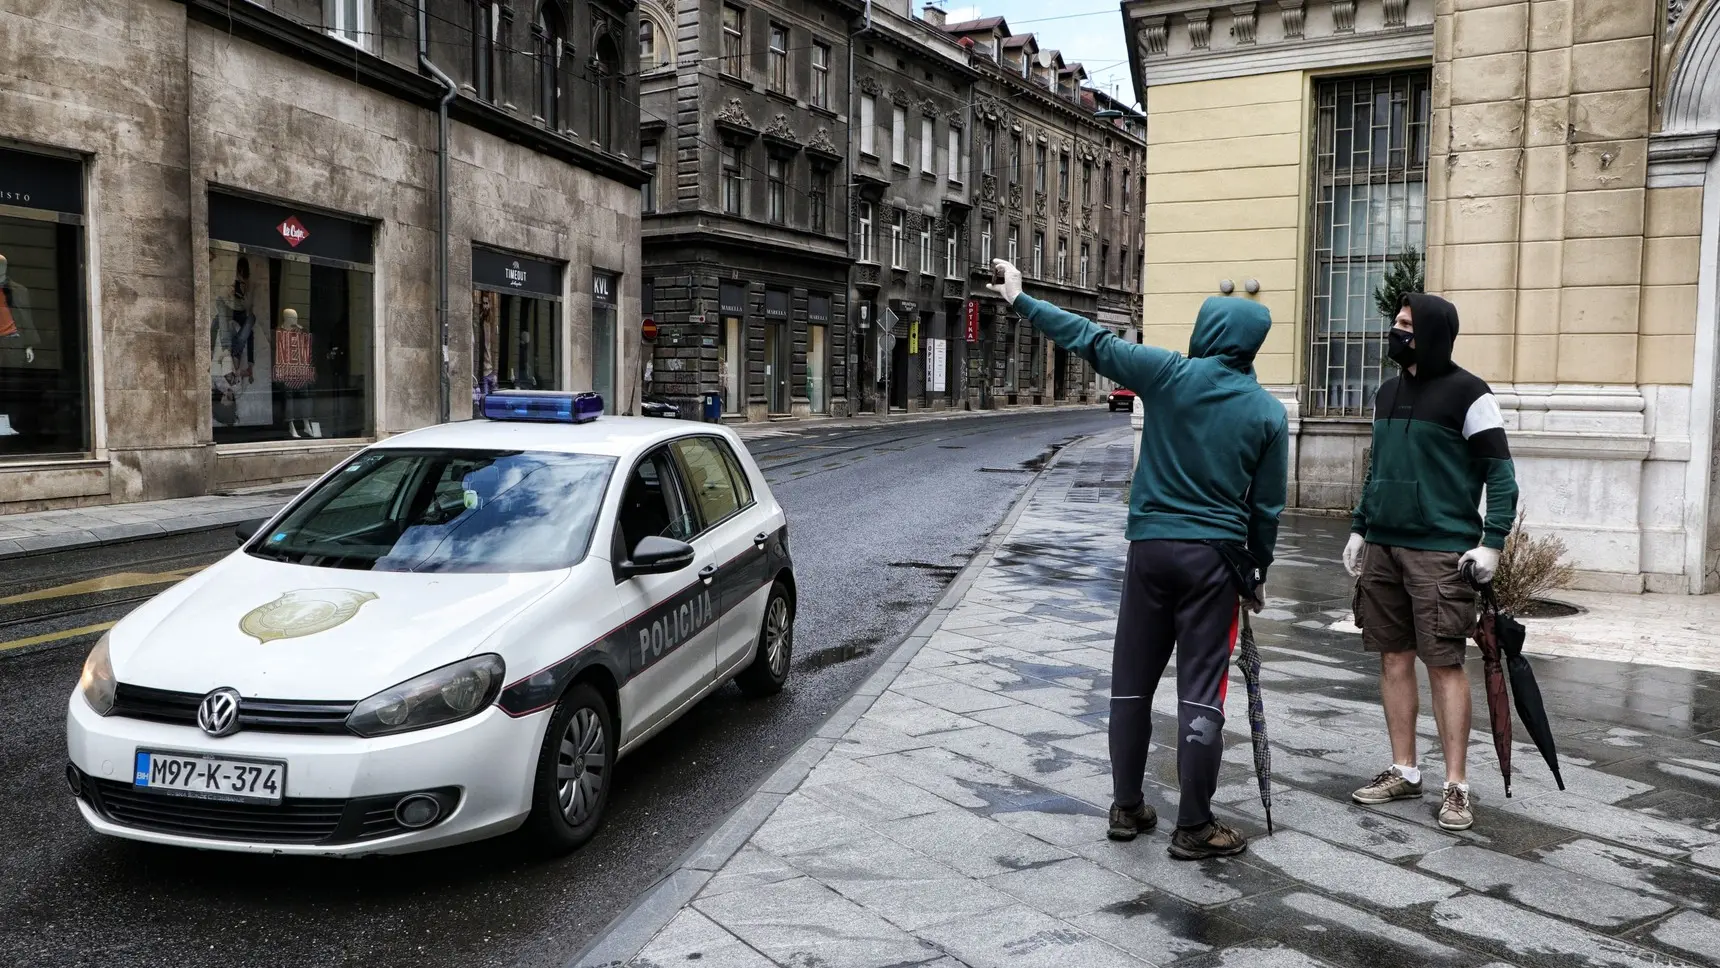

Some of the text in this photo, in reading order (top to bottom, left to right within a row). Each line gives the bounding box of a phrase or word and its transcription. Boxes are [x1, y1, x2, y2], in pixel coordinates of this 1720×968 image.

[505, 268, 527, 281] TIMEOUT
[594, 276, 609, 296] KVL
[721, 304, 743, 312] MARELLA
[766, 308, 787, 316] MARELLA
[276, 330, 313, 365] NEW
[639, 589, 712, 666] POLICIJA
[151, 758, 277, 795] M97-K-374
